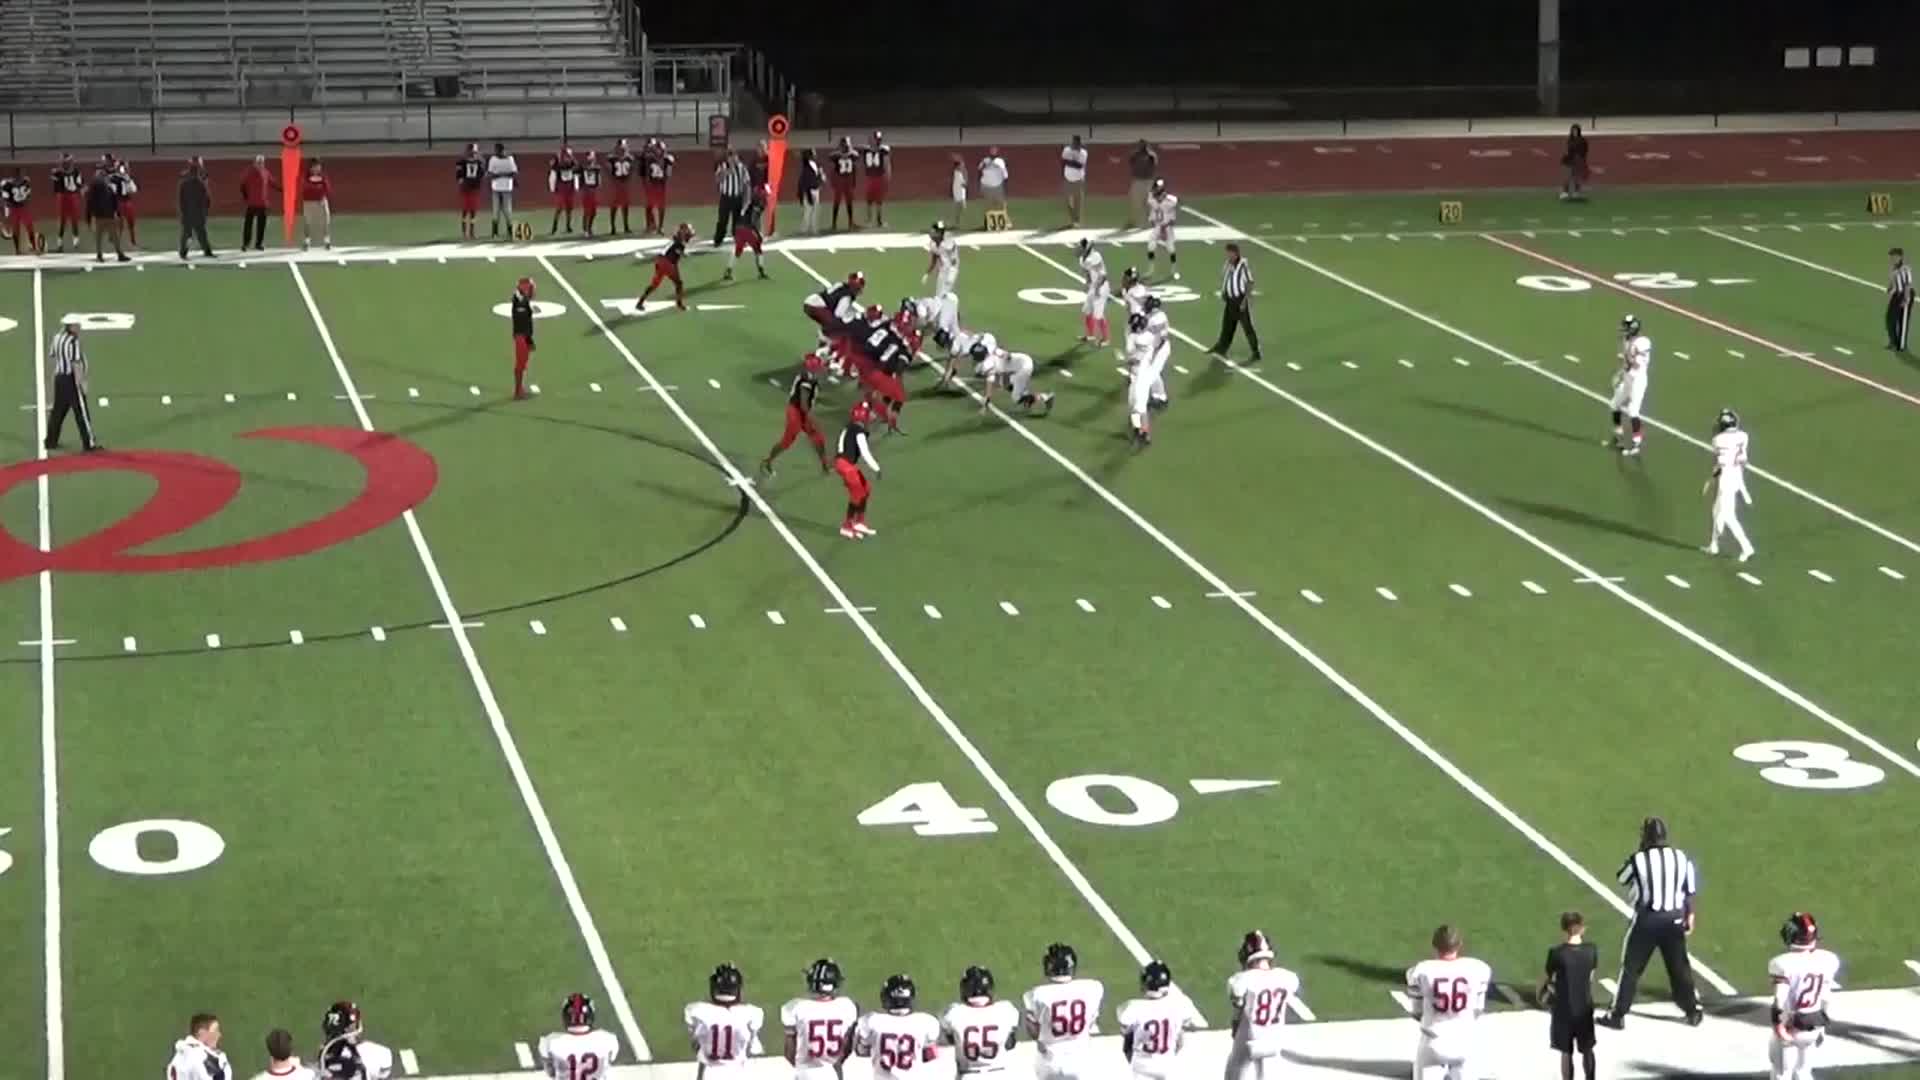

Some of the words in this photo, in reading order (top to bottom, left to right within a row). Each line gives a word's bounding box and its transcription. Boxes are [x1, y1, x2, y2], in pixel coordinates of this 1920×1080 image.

[513, 222, 533, 241] 40
[988, 213, 1006, 231] 30
[857, 775, 1180, 837] 40
[1255, 989, 1288, 1026] 87
[1431, 977, 1467, 1014] 56
[1798, 973, 1824, 1010] 21
[709, 1024, 735, 1060] 11
[807, 1019, 844, 1058] 55
[963, 1024, 999, 1062] 65
[1143, 1018, 1170, 1055] 31
[567, 1052, 599, 1080] 12
